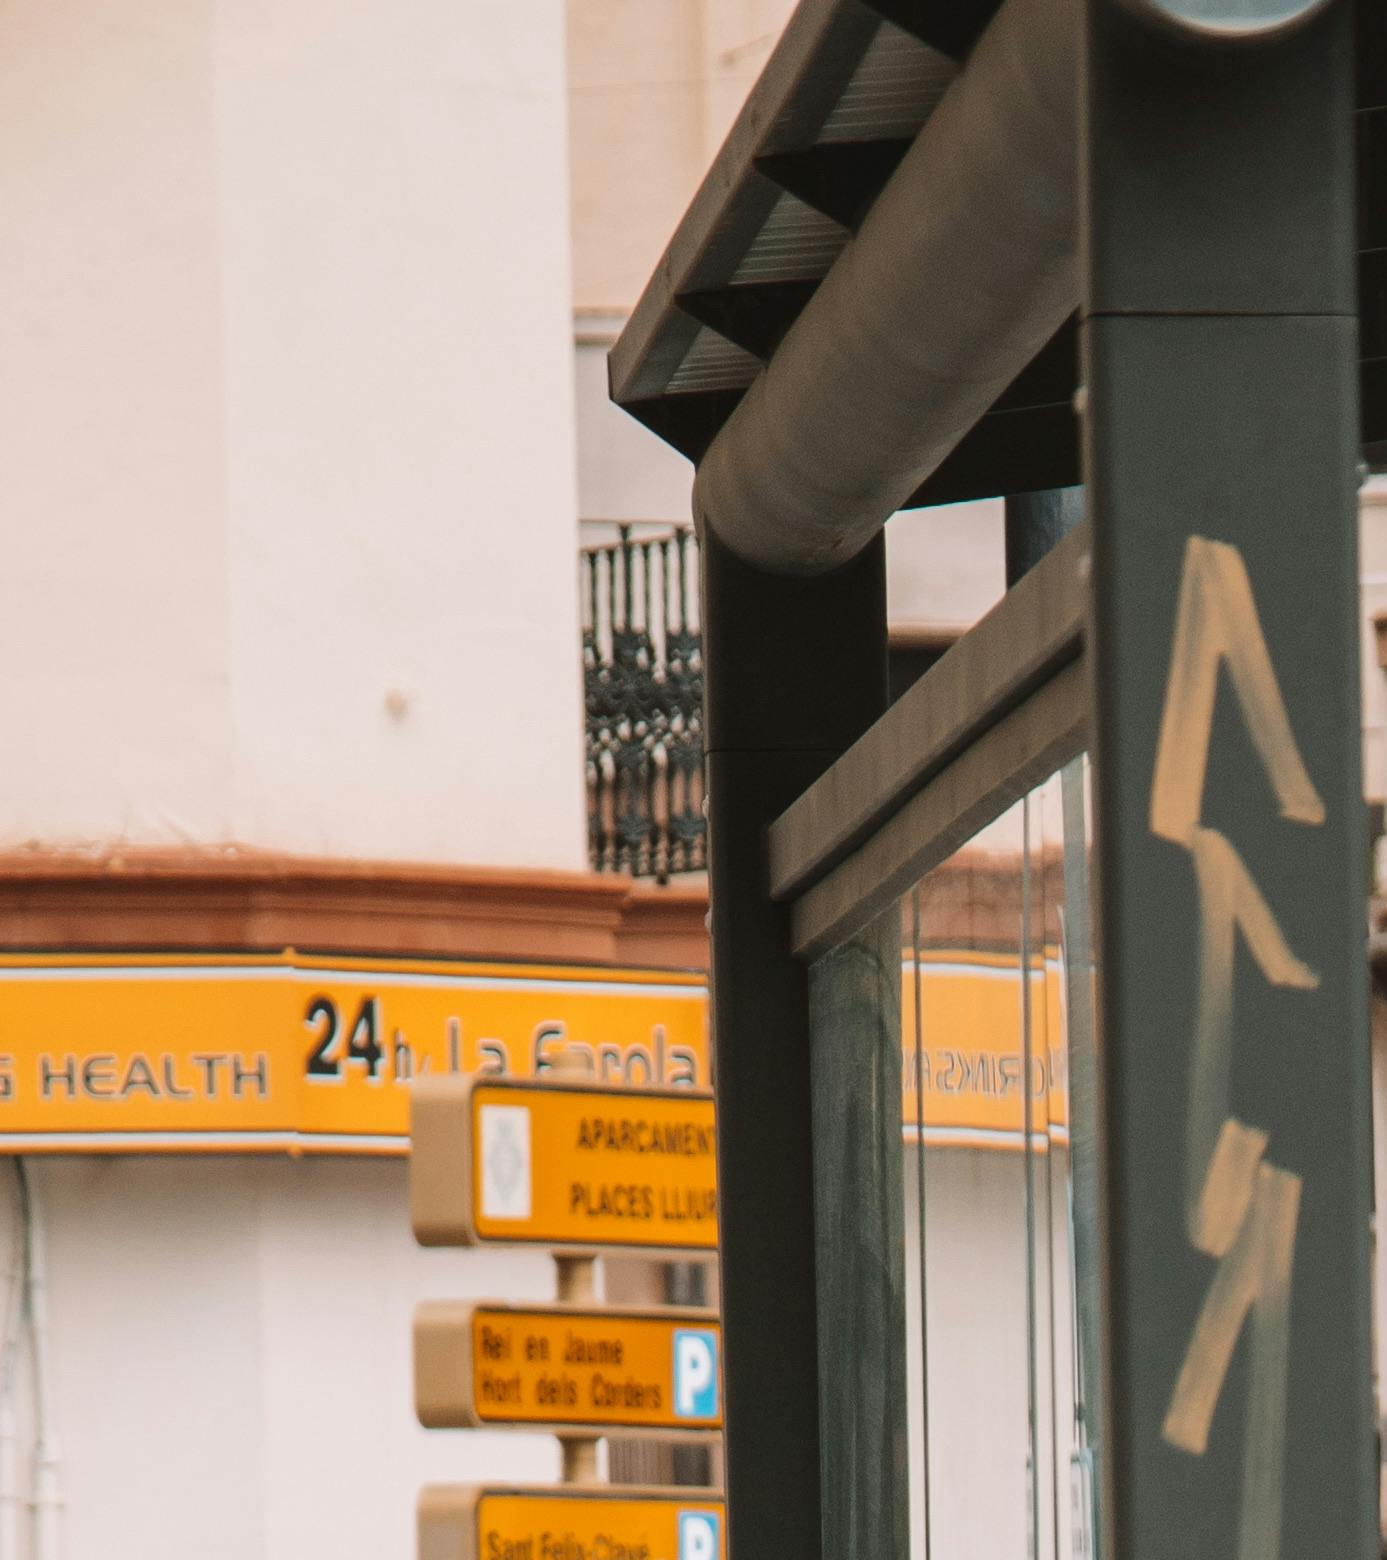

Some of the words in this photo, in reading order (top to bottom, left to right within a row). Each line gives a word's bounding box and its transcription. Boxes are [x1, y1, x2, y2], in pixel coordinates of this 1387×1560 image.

[41, 1054, 268, 1099] HEALTH
[568, 1181, 654, 1219] PLACES
[678, 1334, 712, 1414] P
